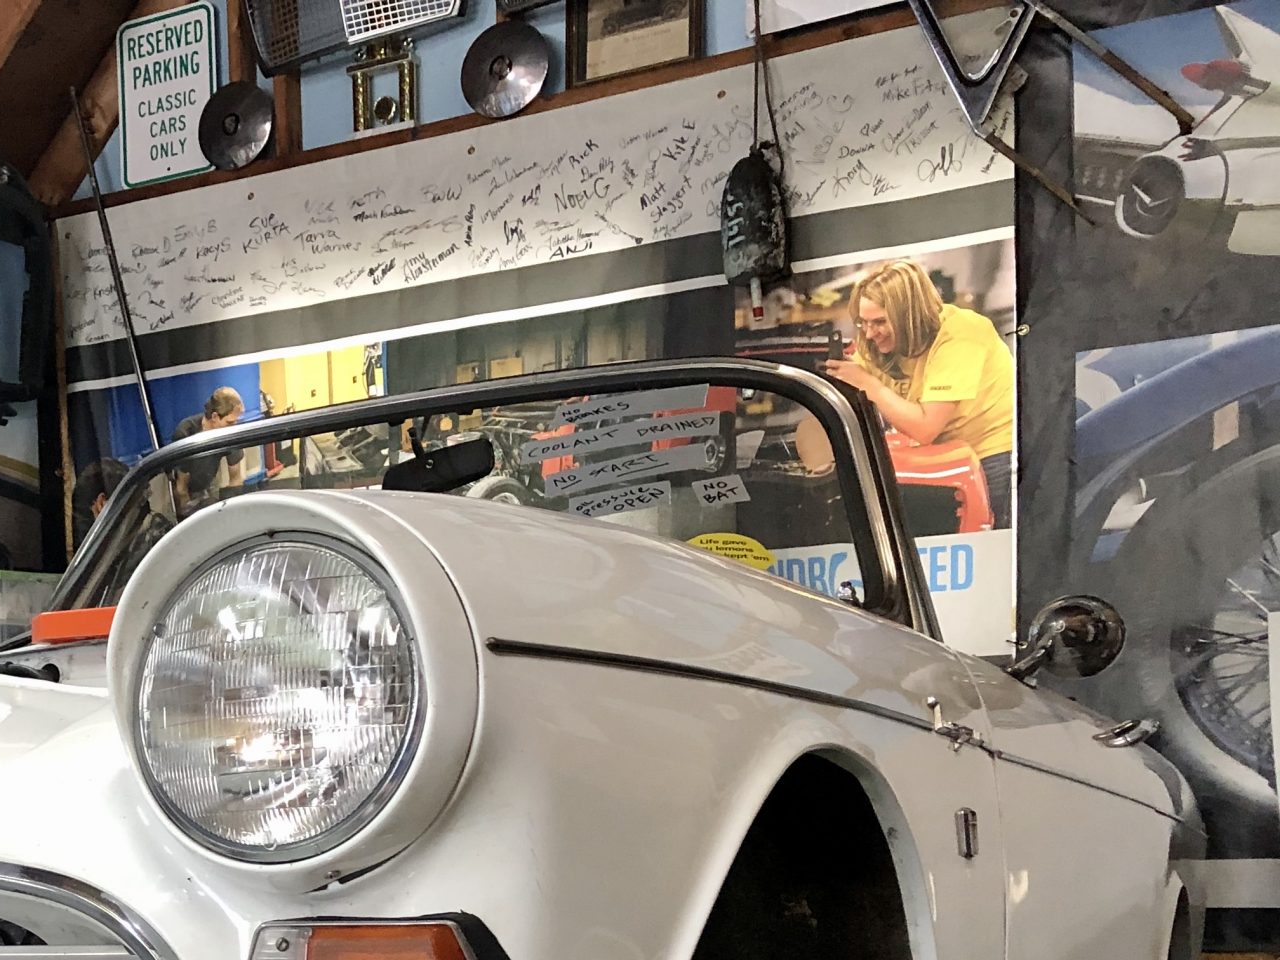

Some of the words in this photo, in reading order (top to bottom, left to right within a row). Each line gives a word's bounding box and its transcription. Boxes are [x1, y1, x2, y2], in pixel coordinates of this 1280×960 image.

[127, 19, 204, 62] RESERVED
[133, 51, 200, 90] PARKING
[138, 89, 196, 118] CLASSIC
[150, 115, 187, 138] CARS
[150, 138, 187, 161] ONLY
[528, 429, 619, 458] COOLANT
[637, 416, 716, 437] DRAINED
[553, 475, 578, 488] NO
[589, 455, 659, 478] START
[703, 481, 727, 491] NO
[703, 487, 738, 504] BAT
[613, 488, 665, 512] OPEN
